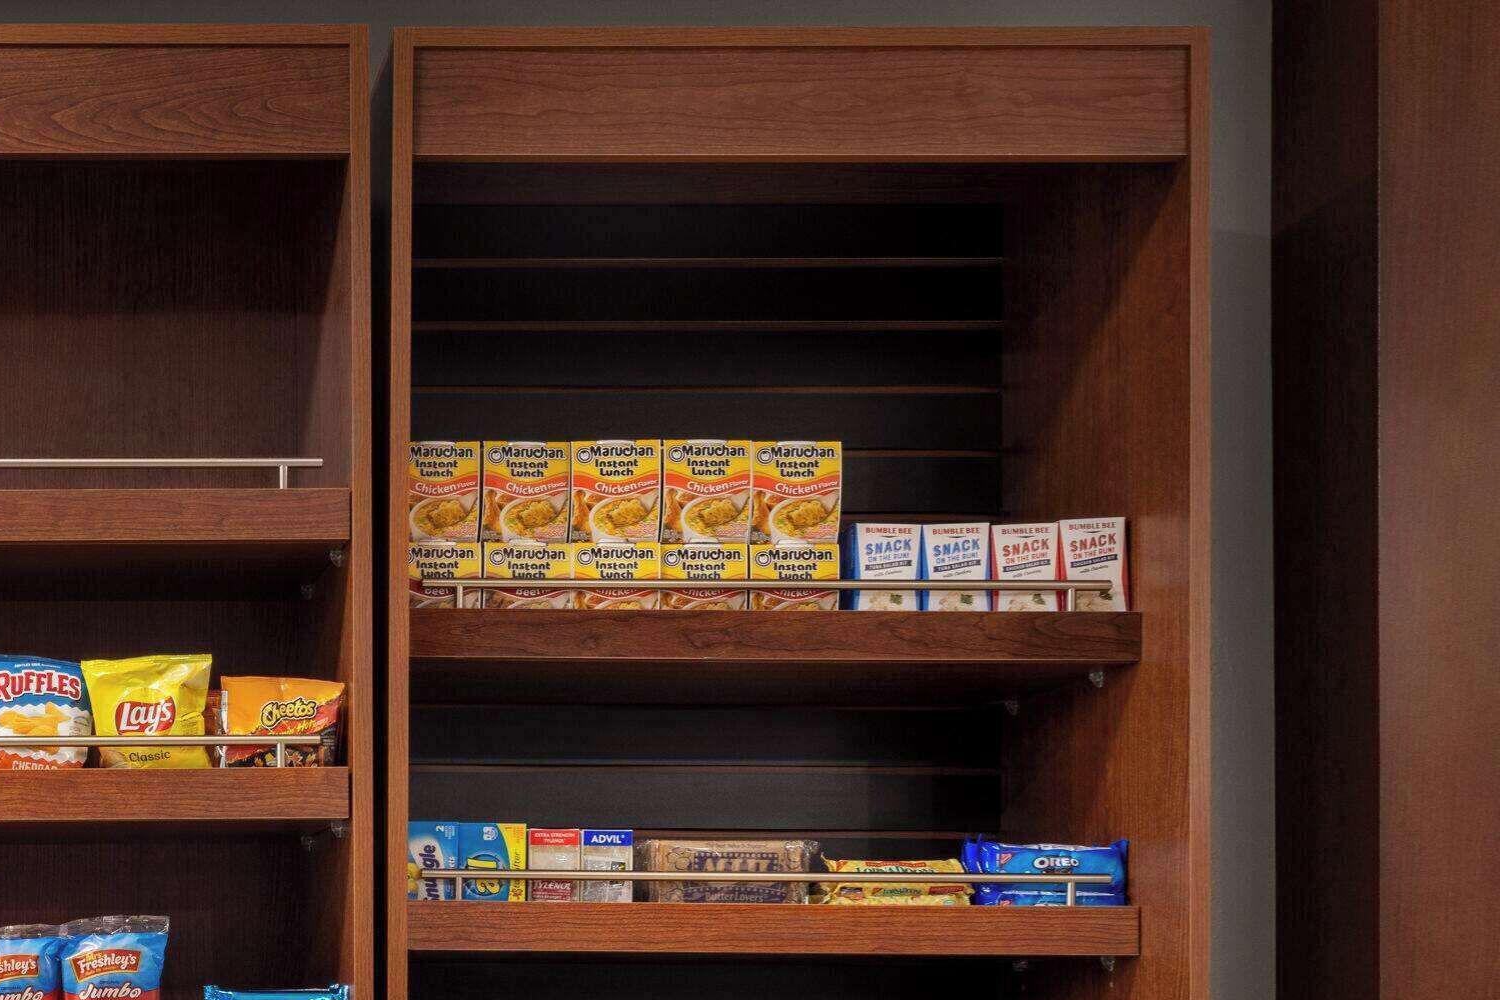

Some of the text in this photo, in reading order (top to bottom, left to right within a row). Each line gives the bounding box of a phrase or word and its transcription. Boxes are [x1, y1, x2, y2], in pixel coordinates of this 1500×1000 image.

[412, 447, 473, 458] Maruchan
[503, 447, 564, 458] Maruchan
[592, 446, 654, 457] Maruchan
[685, 445, 745, 457] Maruchan
[773, 446, 835, 458] Maruchan
[416, 460, 458, 469] Instant
[506, 460, 548, 469] Instant
[595, 459, 638, 468] Instant
[687, 459, 730, 467] Instant
[776, 460, 819, 468] Instant
[420, 469, 453, 477] Lunch
[511, 469, 544, 477] Lunch
[600, 468, 633, 476] Lunch
[692, 468, 725, 476] Lunch
[780, 469, 814, 477] Lunch
[415, 482, 456, 494] Chicken
[506, 482, 547, 494] Chicken
[595, 481, 637, 493] Chicken
[687, 481, 728, 493] Chicken
[776, 483, 817, 494] Chicken
[865, 539, 912, 555] SNACK
[933, 539, 980, 556] SNACK
[1003, 539, 1050, 557] SNACK
[1070, 533, 1116, 552] SNACK
[413, 548, 474, 559] Maruchan
[503, 549, 565, 560] Maruchan
[592, 548, 654, 559] Maruchan
[679, 549, 741, 560] Maruchan
[770, 549, 832, 560] Maruchan
[416, 561, 459, 569] Instant
[508, 561, 550, 570] Instant
[596, 561, 638, 569] Instant
[683, 562, 725, 570] Instant
[773, 562, 817, 571] Instant
[421, 570, 454, 578] Lunch
[513, 570, 546, 579] Lunch
[600, 570, 633, 579] Lunch
[687, 571, 720, 580] Lunch
[779, 571, 812, 580] Lunch
[120, 698, 173, 735] Lay's
[261, 698, 317, 727] Cheetos
[129, 750, 171, 762] Classic
[591, 835, 622, 843] ADVIL
[1034, 857, 1079, 868] OREO
[78, 954, 136, 973] Freshley's
[79, 982, 141, 1000] Jumbo
